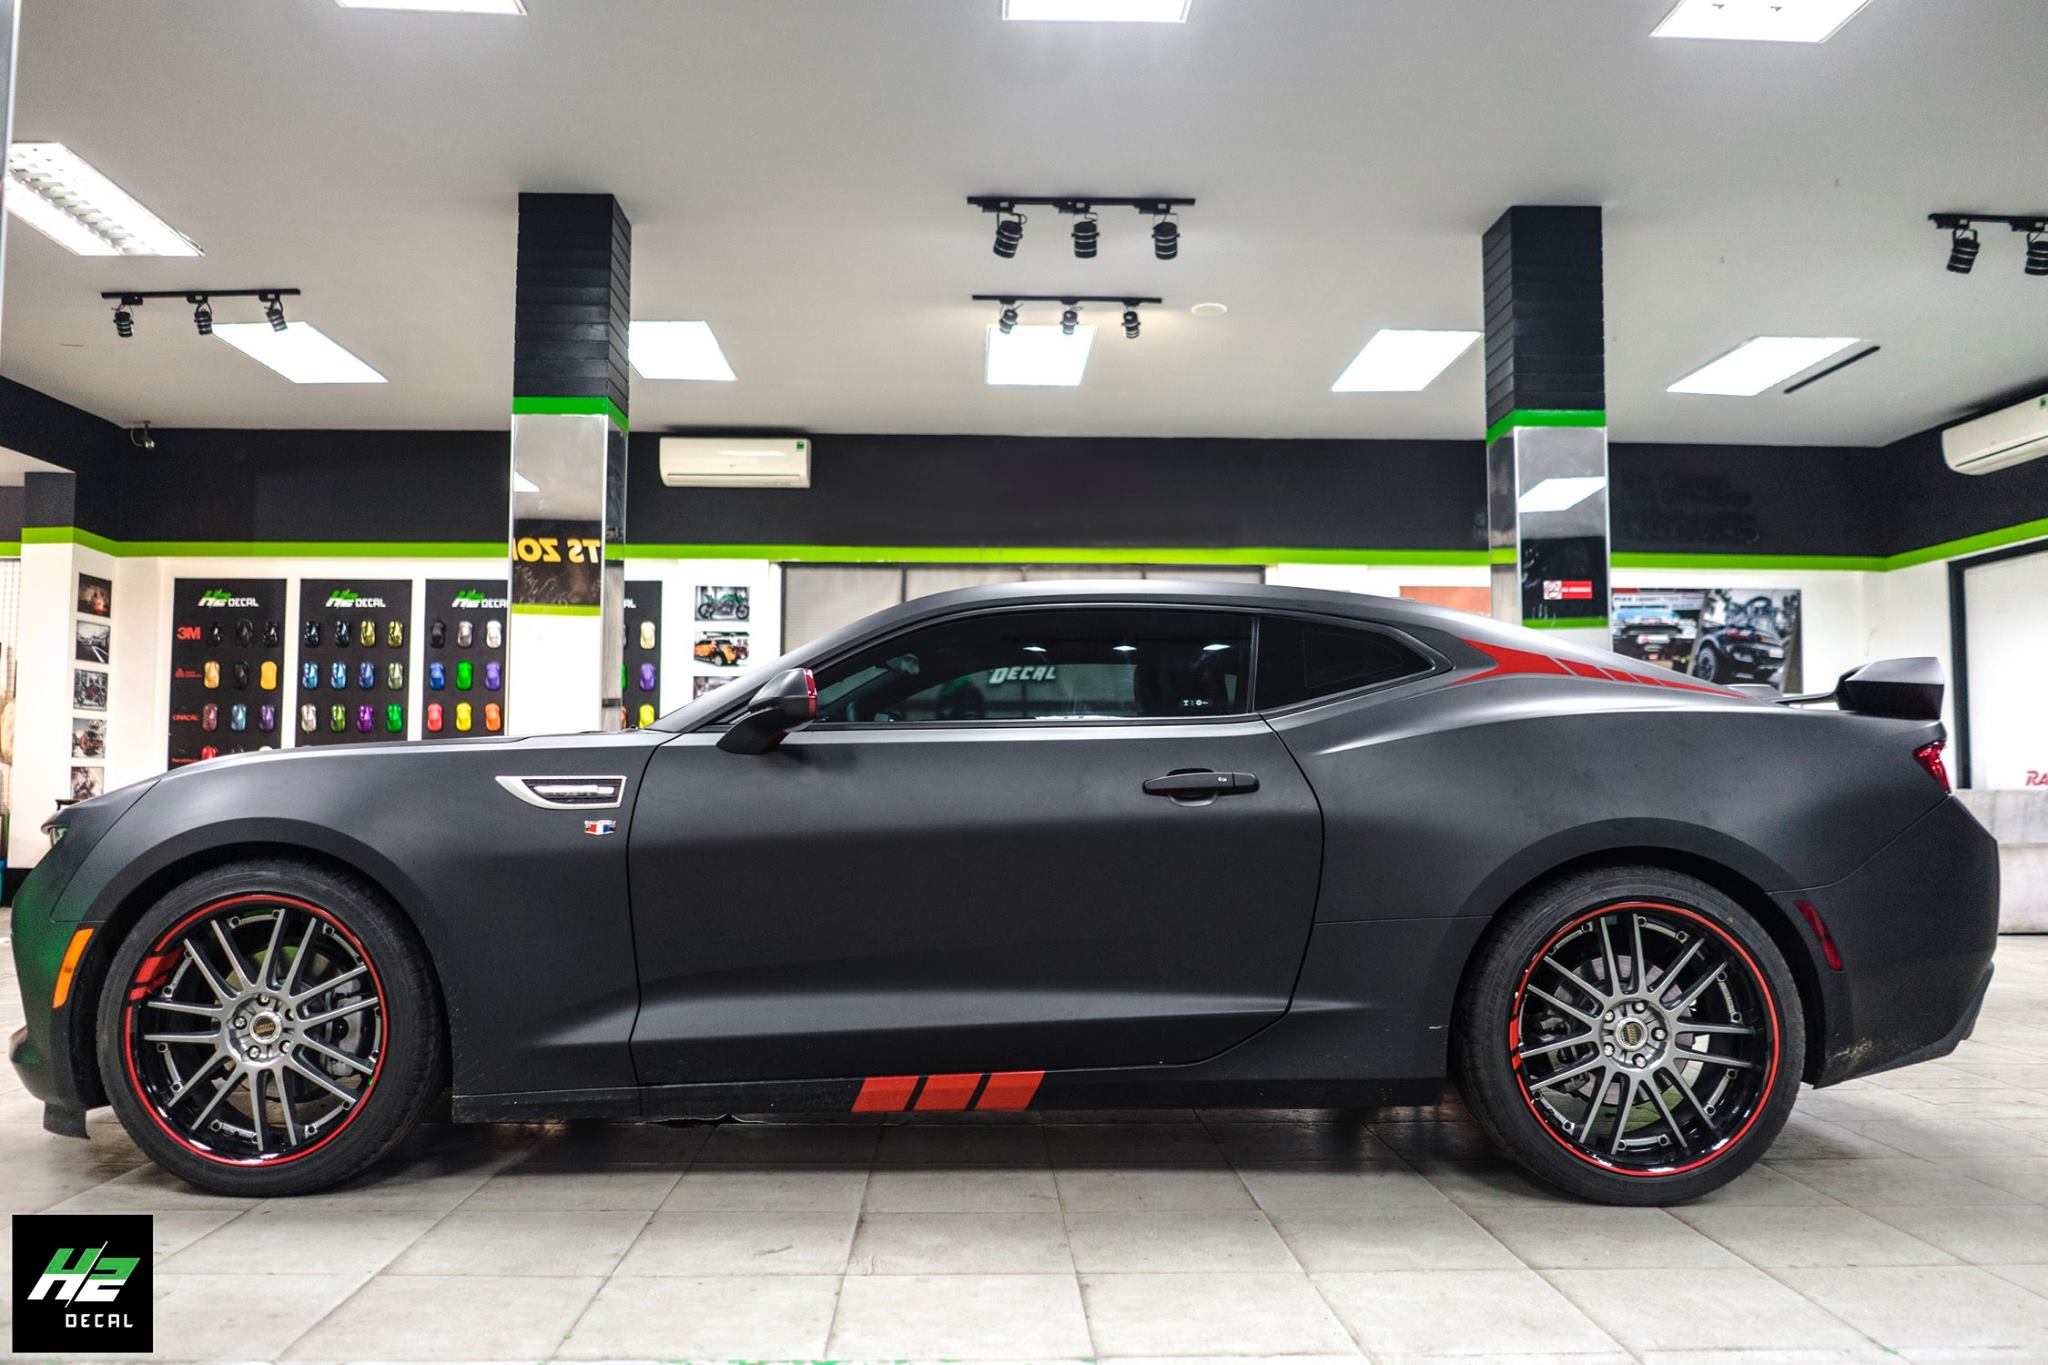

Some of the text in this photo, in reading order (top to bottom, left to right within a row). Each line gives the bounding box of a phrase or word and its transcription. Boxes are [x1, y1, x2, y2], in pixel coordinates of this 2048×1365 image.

[228, 597, 259, 607] DECAL
[355, 597, 386, 607] DECAL
[481, 598, 508, 609] DECA
[177, 626, 200, 640] 3M
[989, 666, 1057, 684] DECAL
